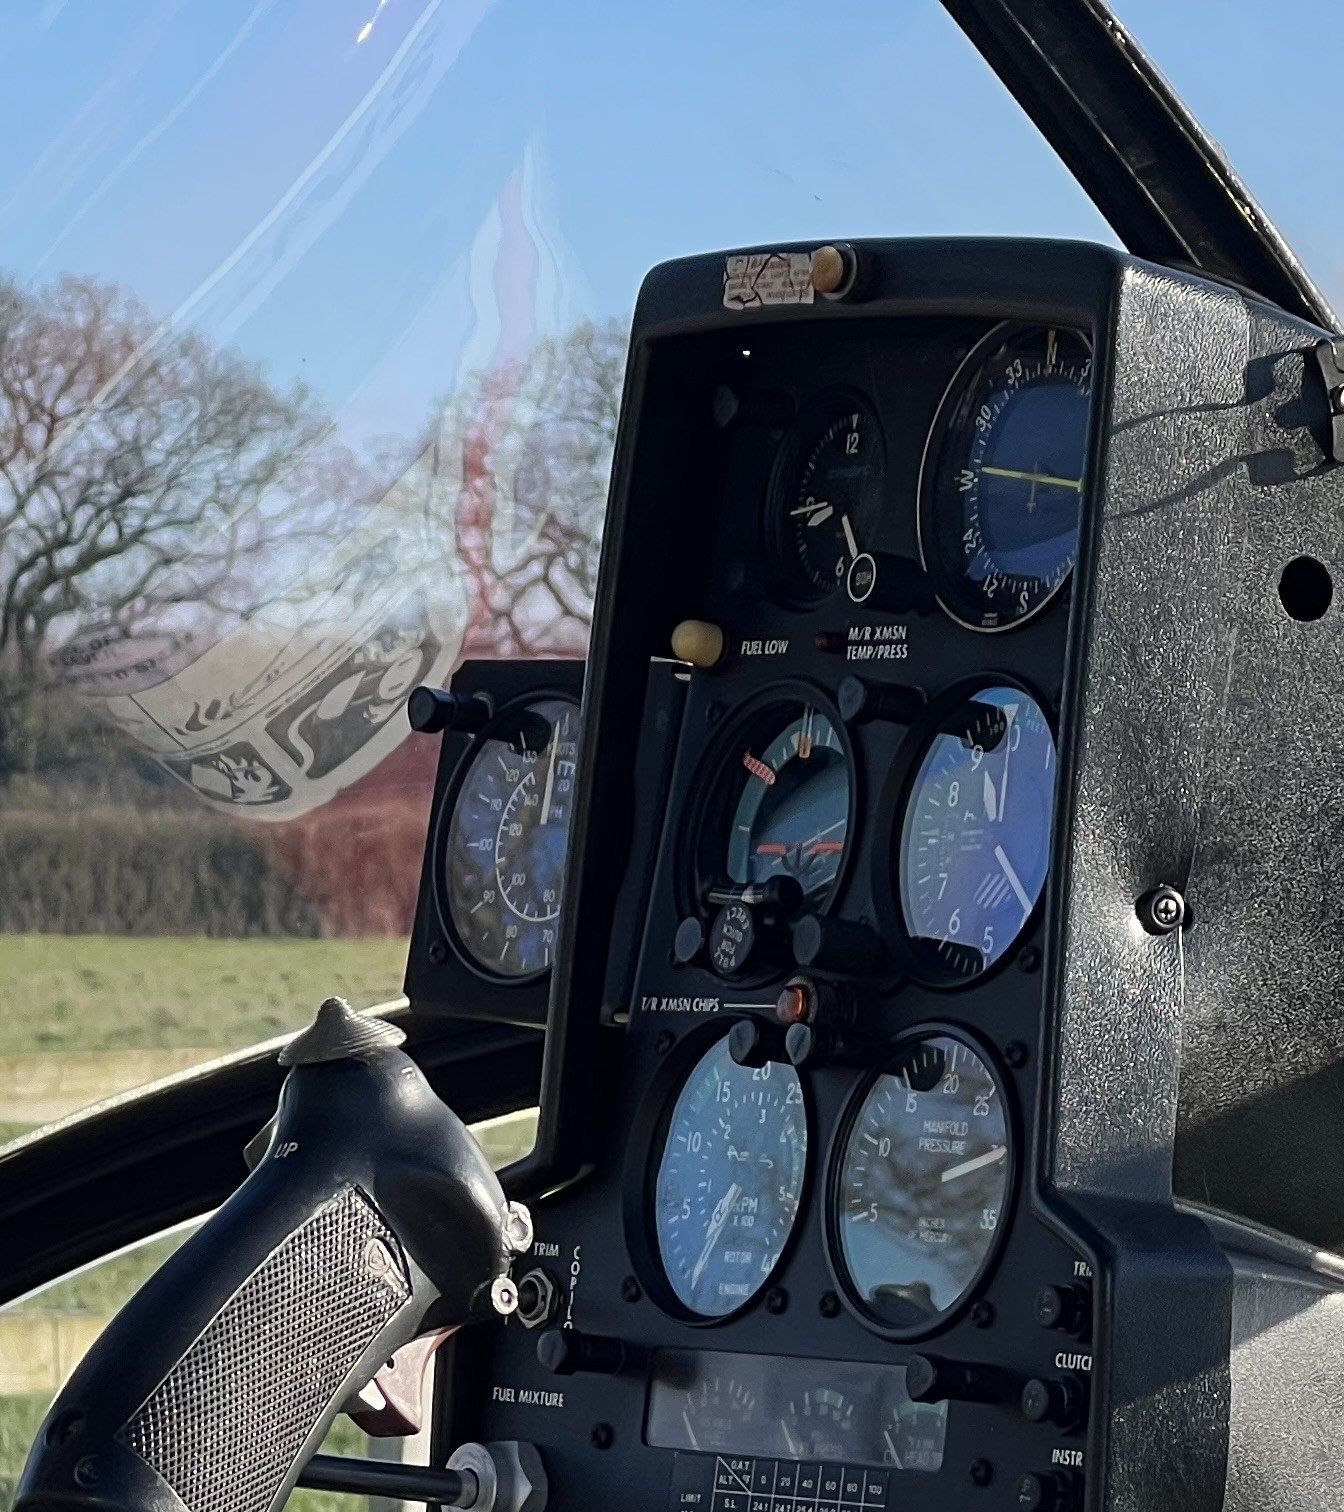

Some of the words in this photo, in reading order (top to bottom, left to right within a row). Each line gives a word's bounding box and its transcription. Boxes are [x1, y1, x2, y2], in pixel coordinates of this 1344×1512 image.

[1047, 342, 1058, 365] N
[1006, 359, 1022, 384] 33
[976, 405, 991, 431] 30
[846, 433, 859, 453] 12
[959, 470, 974, 491] W
[963, 529, 980, 553] 24
[836, 556, 844, 576] 6
[1019, 591, 1029, 614] S
[848, 626, 871, 641] M/R
[873, 625, 907, 640] XMSN
[741, 641, 762, 655] FUEL
[765, 640, 789, 654] LOW
[847, 644, 908, 660] TEMP/PRESS
[971, 745, 983, 771] 9
[506, 769, 520, 782] 120
[558, 779, 570, 791] 20
[948, 782, 959, 806] 8
[490, 799, 503, 811] 110
[509, 823, 523, 836] 120
[479, 839, 493, 850] 100
[511, 873, 526, 886] 100
[937, 873, 948, 899] 7
[483, 890, 495, 903] 90
[543, 889, 555, 902] 80
[948, 908, 960, 934] 6
[506, 926, 518, 938] 80
[542, 929, 553, 943] 70
[982, 926, 994, 953] 5
[641, 997, 657, 1011] T/R
[659, 997, 691, 1011] XMSN
[692, 997, 719, 1012] CHIPS
[716, 1081, 731, 1102] 15
[943, 1074, 959, 1093] 20
[786, 1083, 803, 1104] 25
[906, 1093, 917, 1112] 15
[973, 1096, 989, 1116] 25
[759, 1109, 766, 1124] 3
[723, 1125, 731, 1139] 2
[923, 1120, 968, 1136] MANIFOLD
[275, 1142, 298, 1158] UP
[687, 1132, 701, 1153] 10
[878, 1137, 890, 1157] 10
[919, 1137, 967, 1155] PRESSURE
[778, 1187, 785, 1201] 5
[682, 1199, 690, 1220] 5
[869, 1203, 878, 1222] 5
[980, 1209, 997, 1230] 35
[534, 1242, 559, 1257] TRIM
[723, 1251, 752, 1264] ROTOR
[719, 1283, 749, 1297] ENGINE
[1055, 1353, 1092, 1370] CLUTC
[493, 1387, 515, 1402] FUEL
[519, 1390, 564, 1407] MIXTURE
[1051, 1449, 1083, 1467] INSTR
[761, 1475, 766, 1484] 0
[802, 1479, 813, 1489] 40
[825, 1481, 836, 1491] 60
[869, 1485, 882, 1495] 100
[681, 1494, 701, 1503] LIMIT
